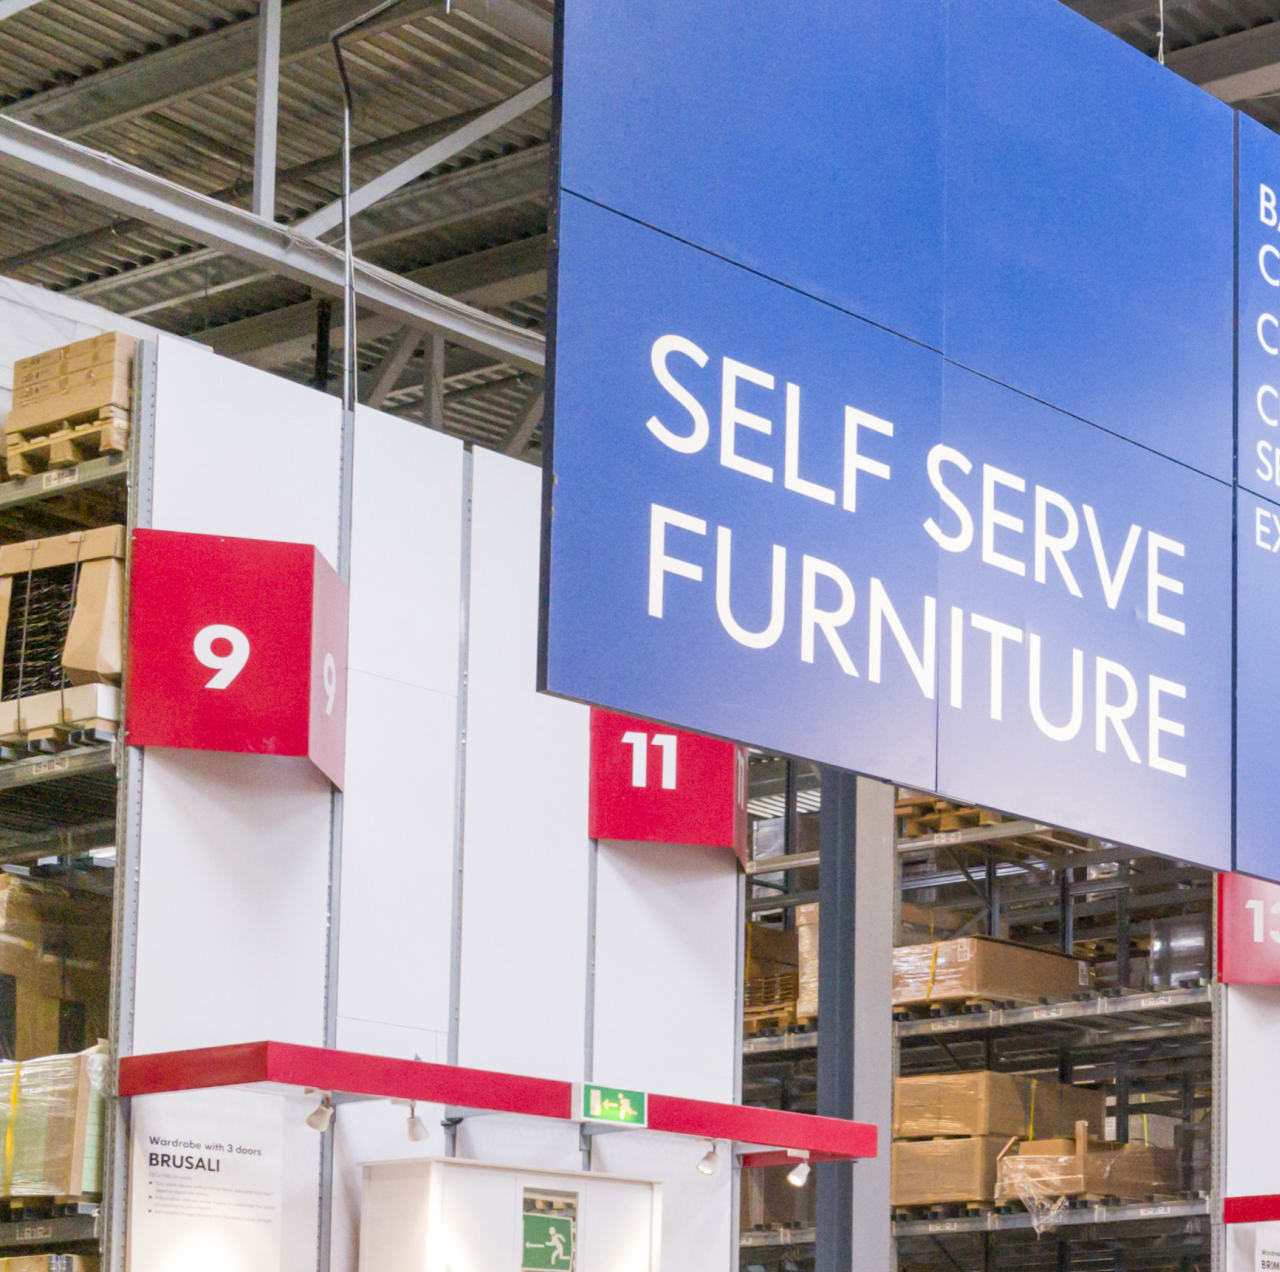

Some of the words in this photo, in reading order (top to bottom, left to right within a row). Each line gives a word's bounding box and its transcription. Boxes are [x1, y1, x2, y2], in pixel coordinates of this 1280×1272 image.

[646, 334, 893, 512] SELF
[923, 443, 1187, 636] SERVE
[193, 624, 250, 690] 9
[647, 503, 1188, 777] FURNITURE
[323, 652, 337, 716] 9
[621, 731, 677, 790] 11
[149, 1136, 202, 1150] Wardrobe
[204, 1143, 224, 1153] with
[226, 1144, 233, 1153] 3
[235, 1145, 262, 1156] doors
[149, 1153, 220, 1172] BRUSALI
